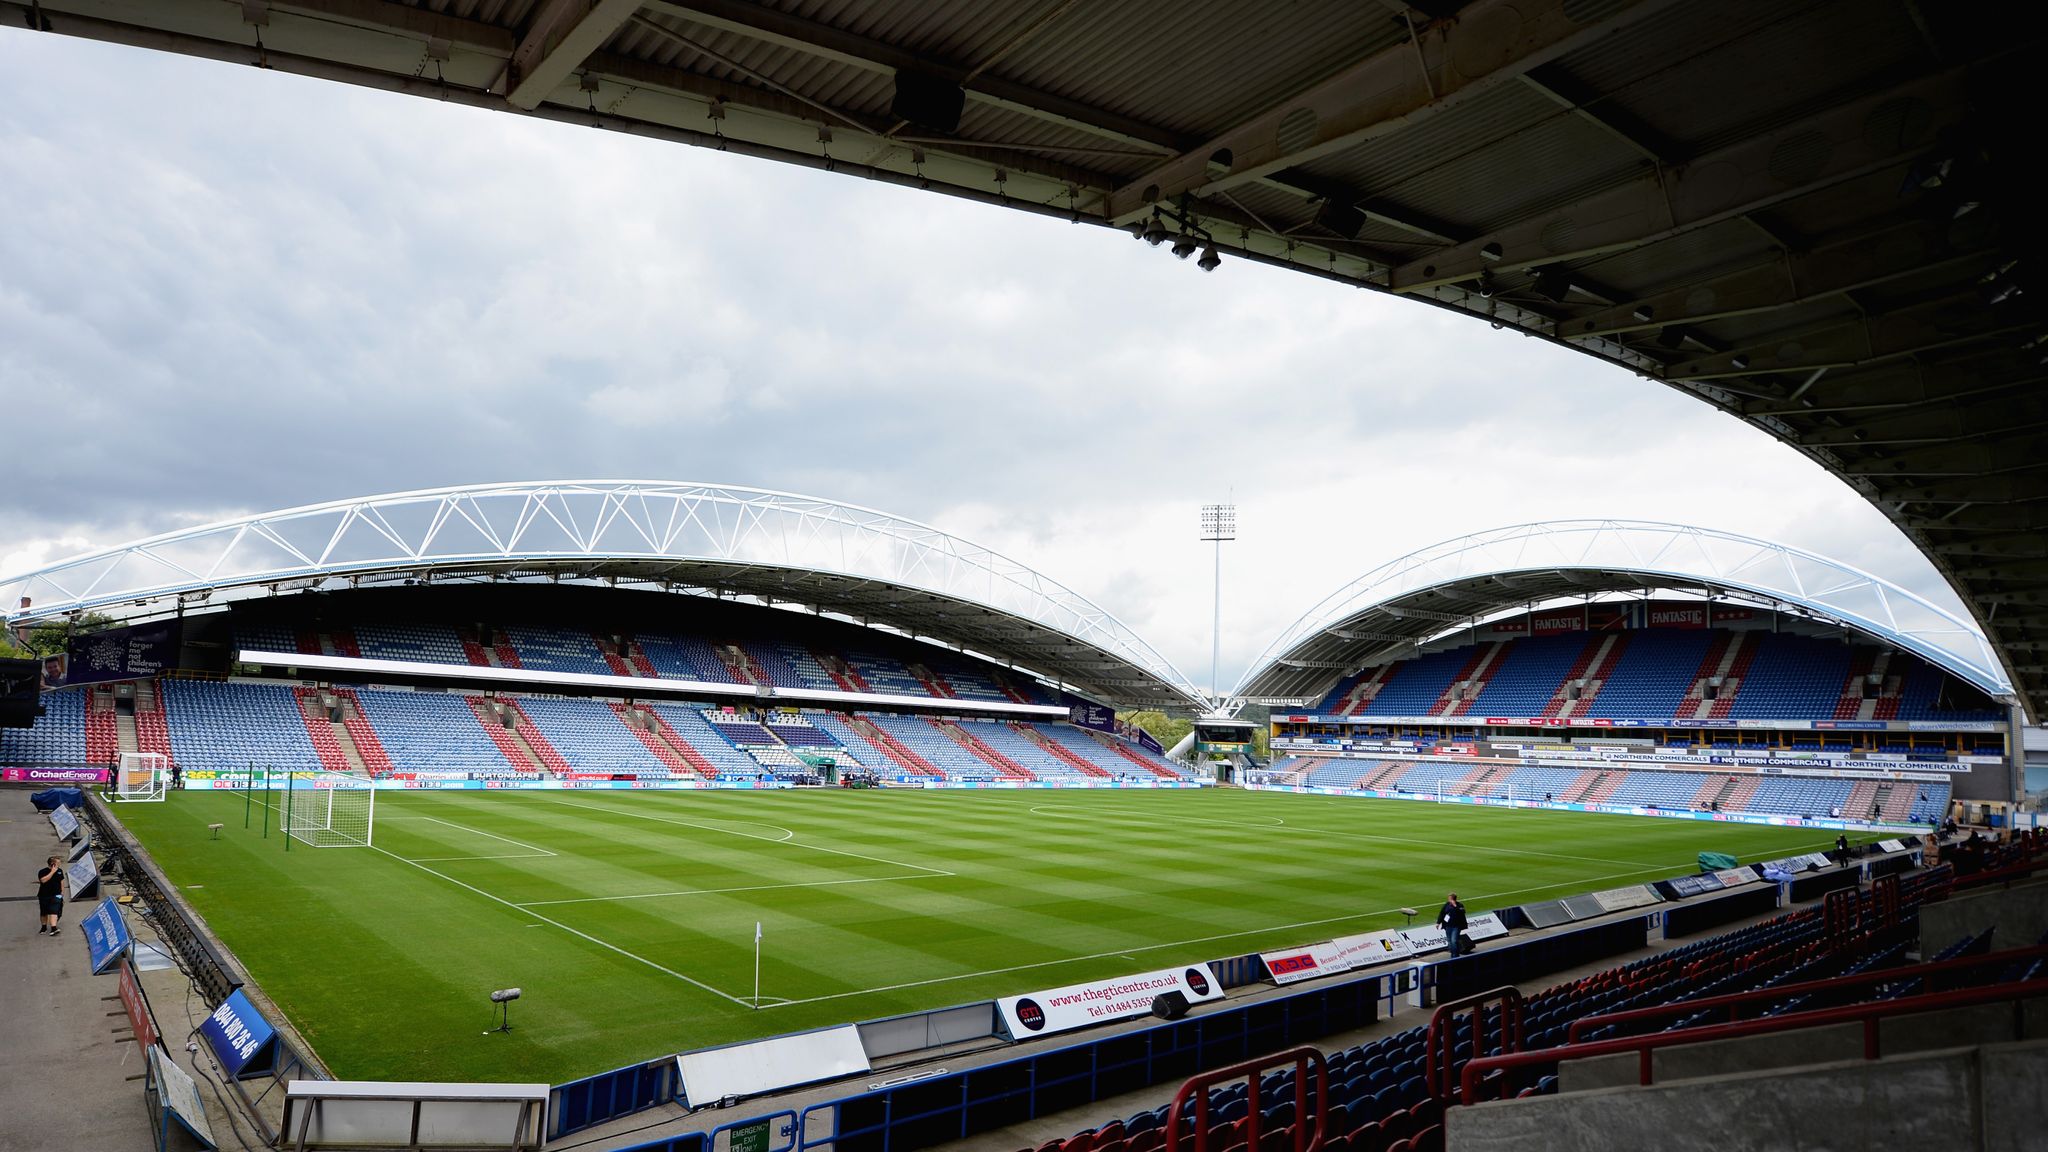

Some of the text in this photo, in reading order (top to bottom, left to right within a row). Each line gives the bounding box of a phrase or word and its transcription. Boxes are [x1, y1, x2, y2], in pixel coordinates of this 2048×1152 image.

[1652, 611, 1702, 624] FANTASTIC
[1535, 617, 1581, 630] FANTASTIC
[129, 641, 153, 650] forget
[128, 660, 162, 668] children's
[127, 666, 155, 674] hospice
[1721, 757, 1767, 765] NORTHERN
[1899, 763, 1967, 771] COMMERCIALS
[1412, 938, 1427, 949] Dale
[1277, 973, 1297, 983] PROPERTY
[1297, 971, 1314, 980] SERVICES
[1049, 974, 1179, 1008] www.thegticentre.co.uk
[1020, 1005, 1040, 1018] GTI
[1087, 1005, 1106, 1018] Tel:
[1105, 1000, 1132, 1015] 01484
[213, 1003, 259, 1060] 0844 800 26 46
[732, 1122, 769, 1138] EMERGENCY
[743, 1134, 757, 1145] EXIT
[742, 1143, 758, 1152] ONLY
